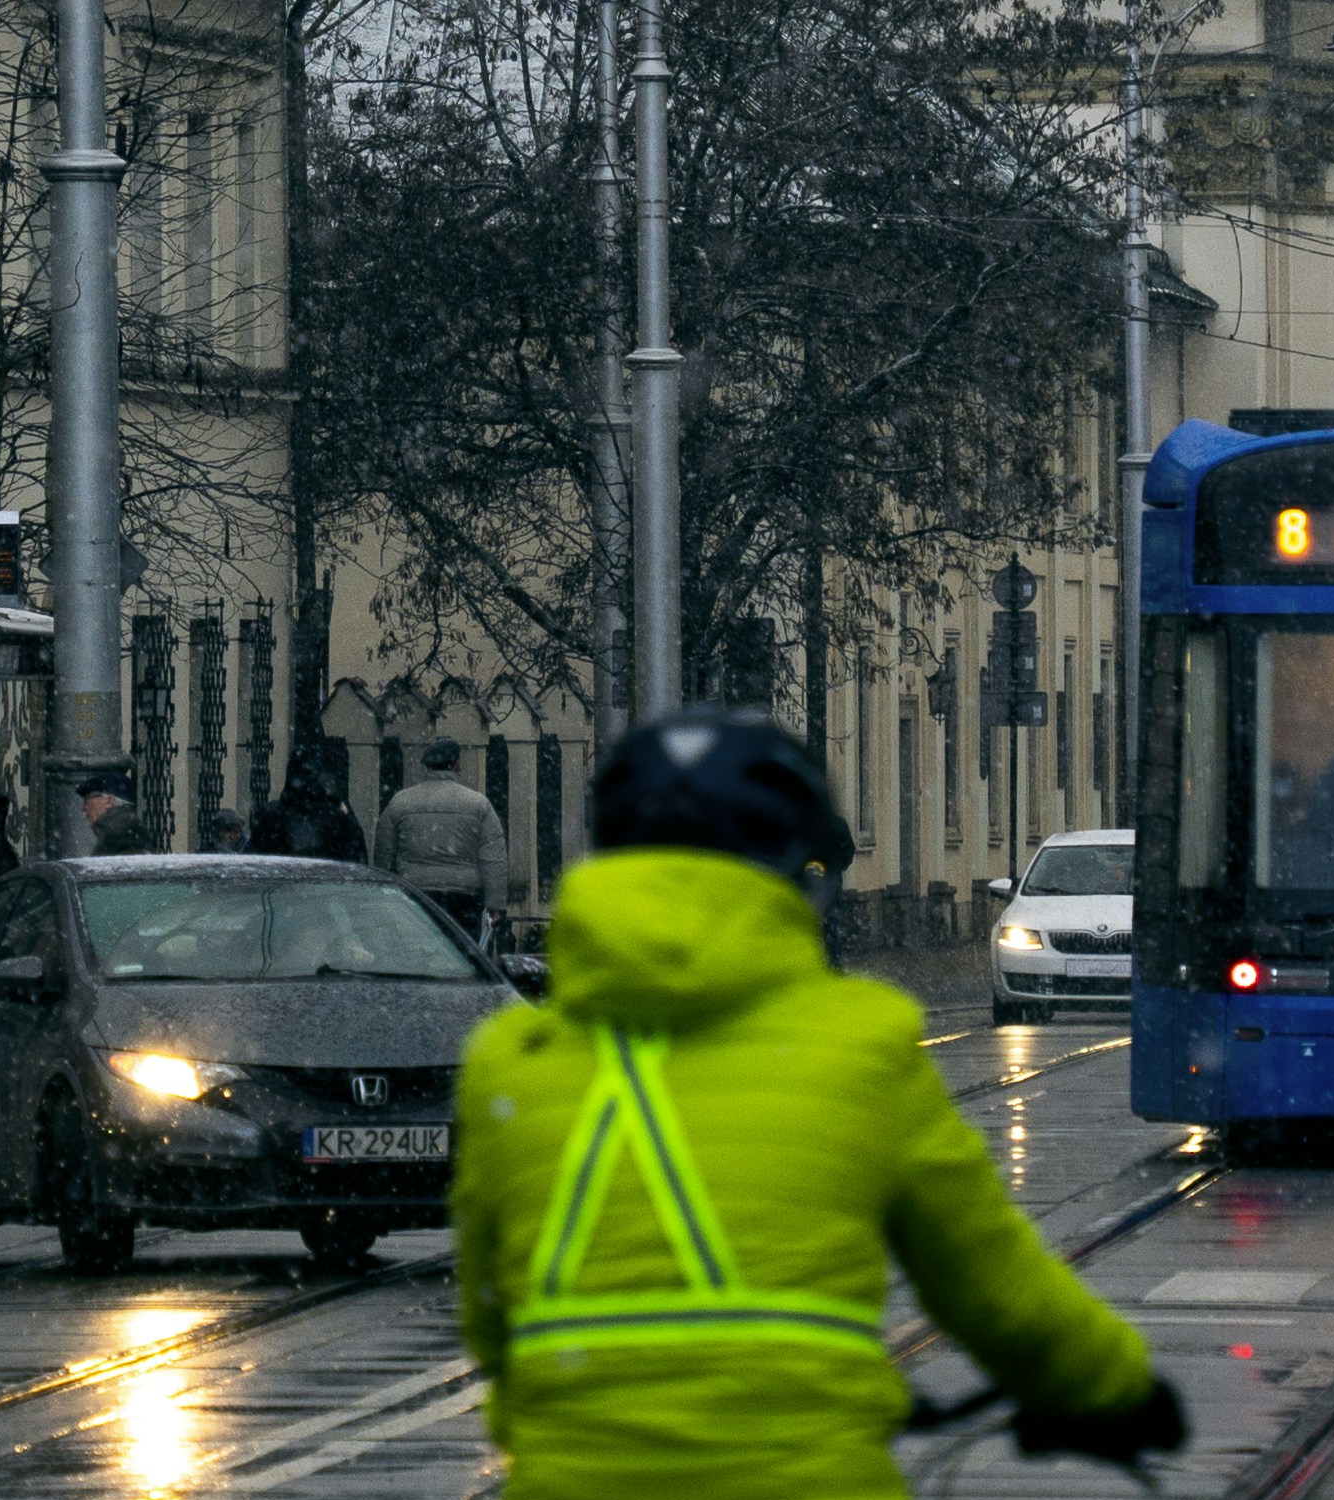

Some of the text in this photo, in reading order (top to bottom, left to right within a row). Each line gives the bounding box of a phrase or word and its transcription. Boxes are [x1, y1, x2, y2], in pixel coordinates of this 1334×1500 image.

[1278, 508, 1308, 555] 8
[318, 1129, 444, 1155] KR 294UK
